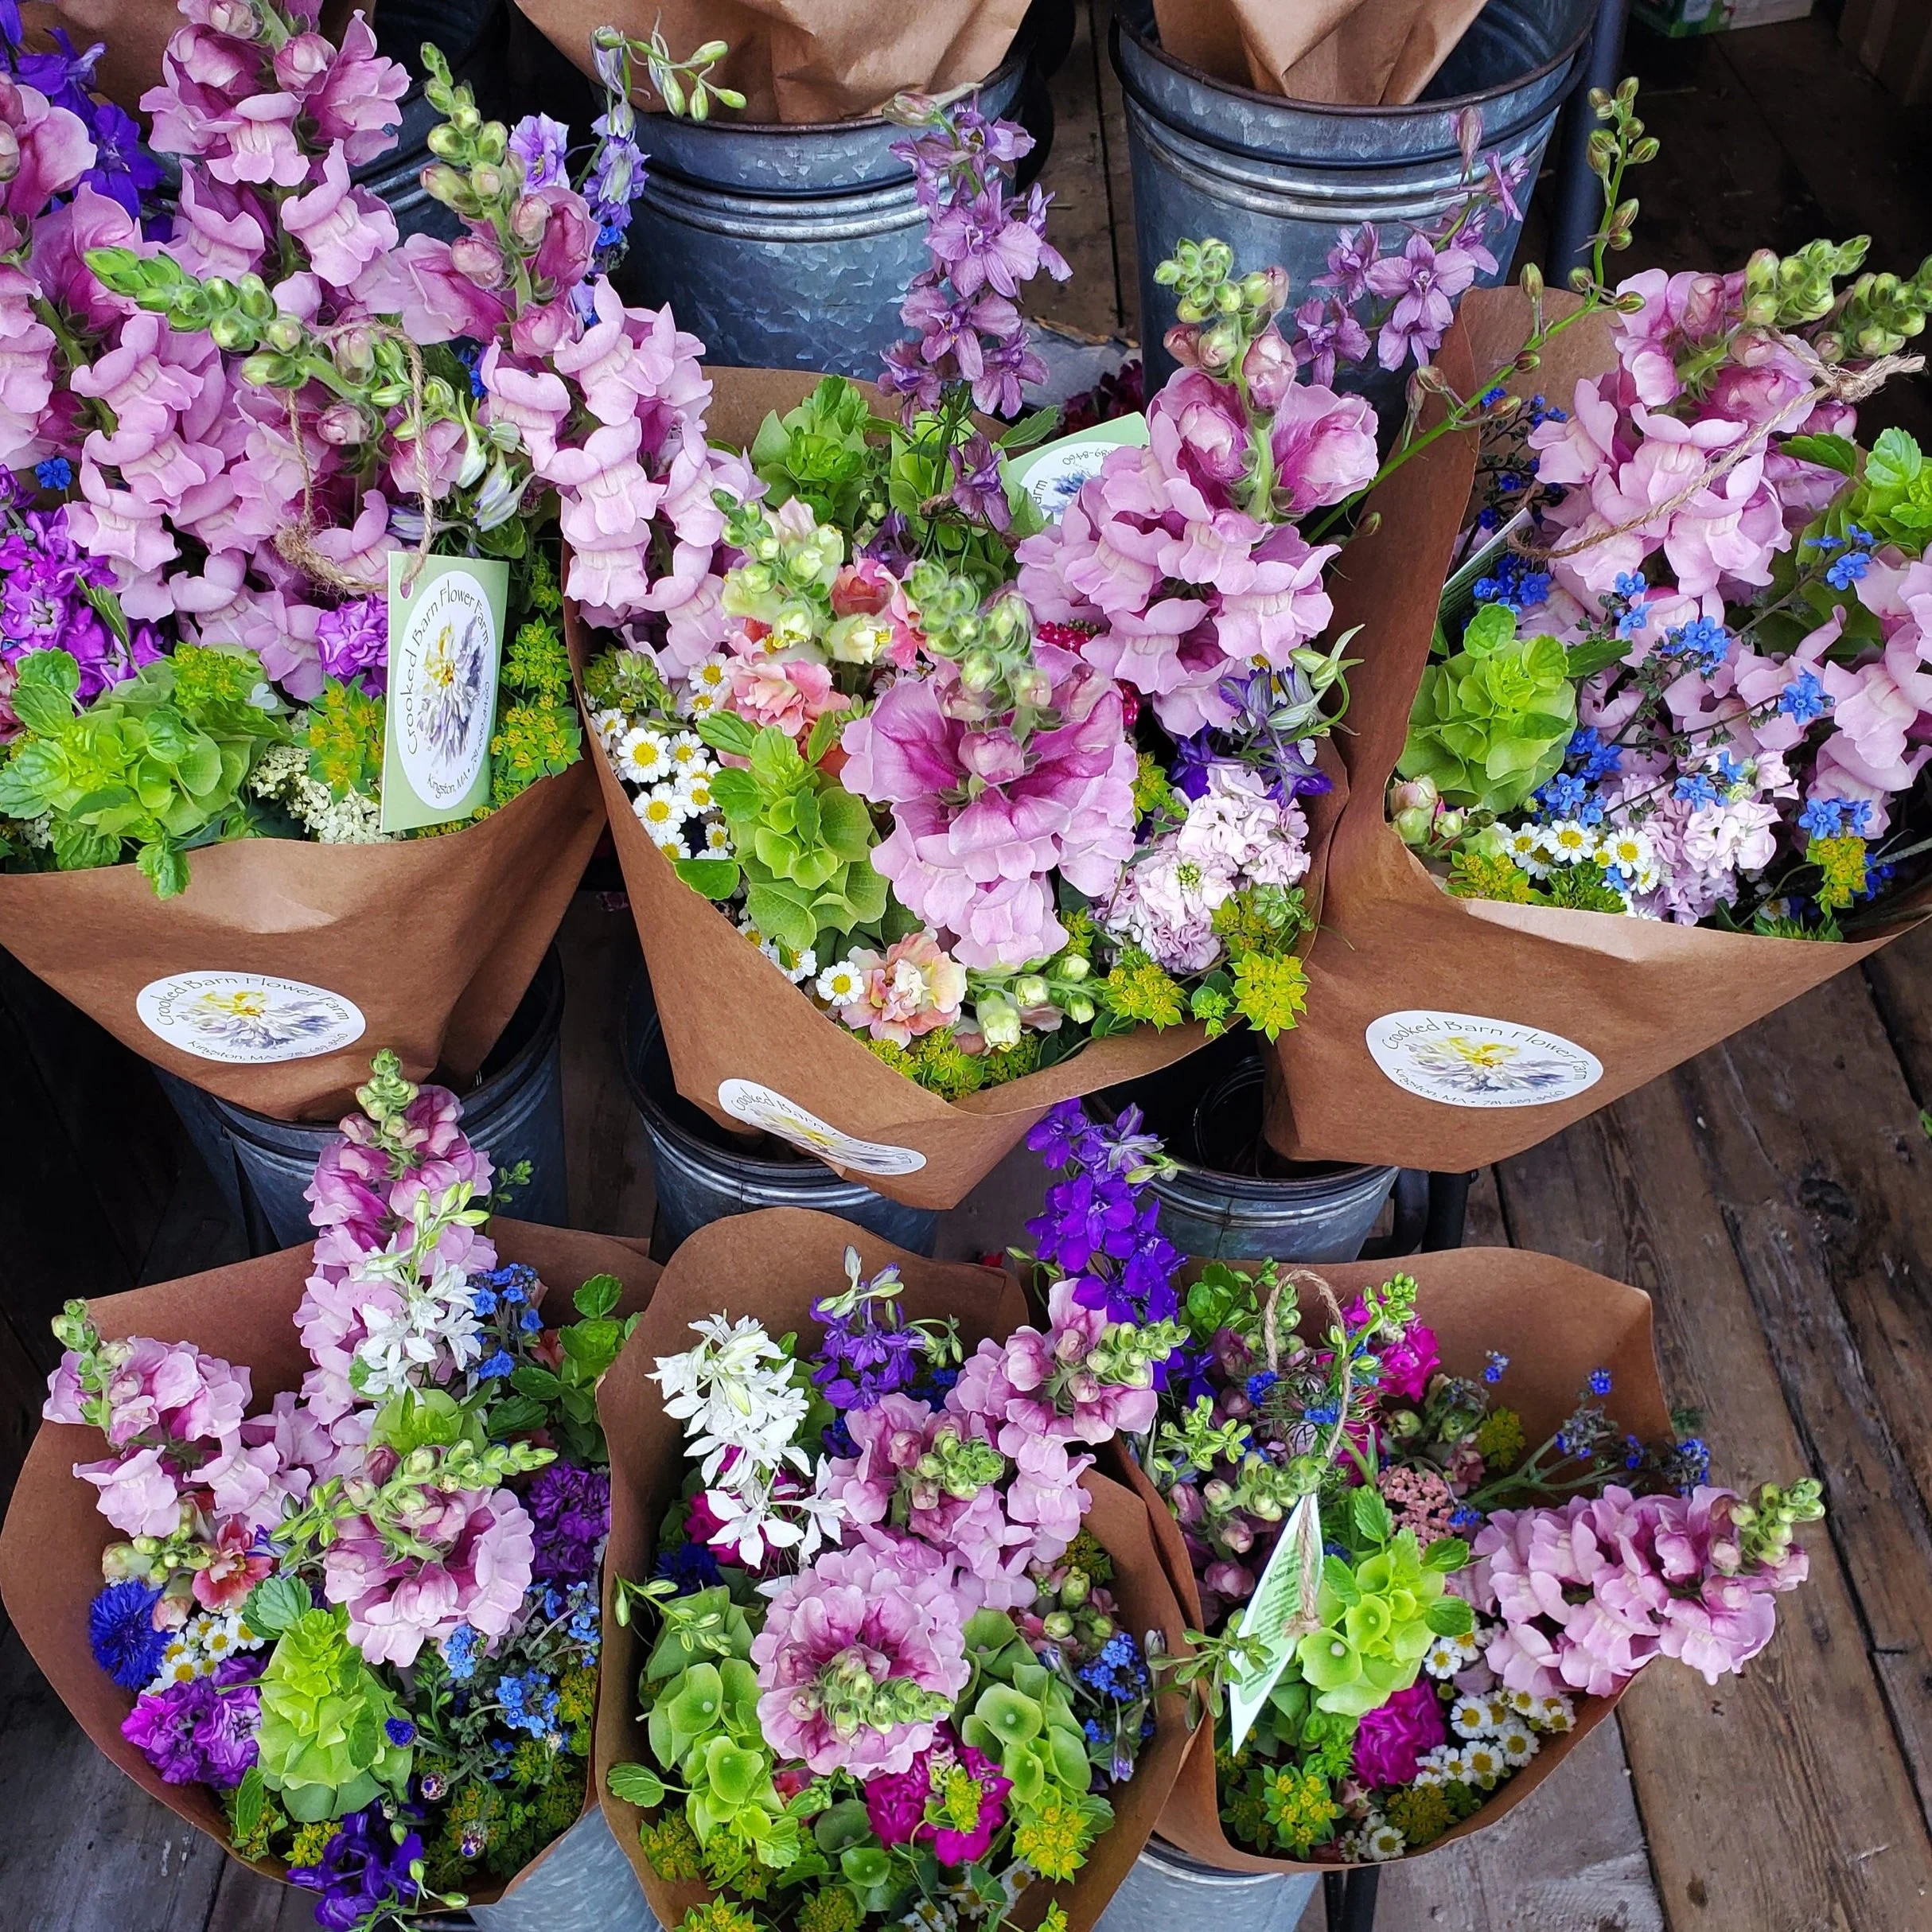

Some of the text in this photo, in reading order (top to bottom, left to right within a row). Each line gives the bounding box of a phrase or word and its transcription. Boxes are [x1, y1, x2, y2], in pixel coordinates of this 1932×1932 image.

[1033, 479, 1048, 504] arm
[399, 579, 489, 755] Crooked Barn Flower Farm
[157, 976, 350, 1026] Crooked Barn Flower Farm
[1381, 1018, 1590, 1081] Crooked Barn Flower Farm
